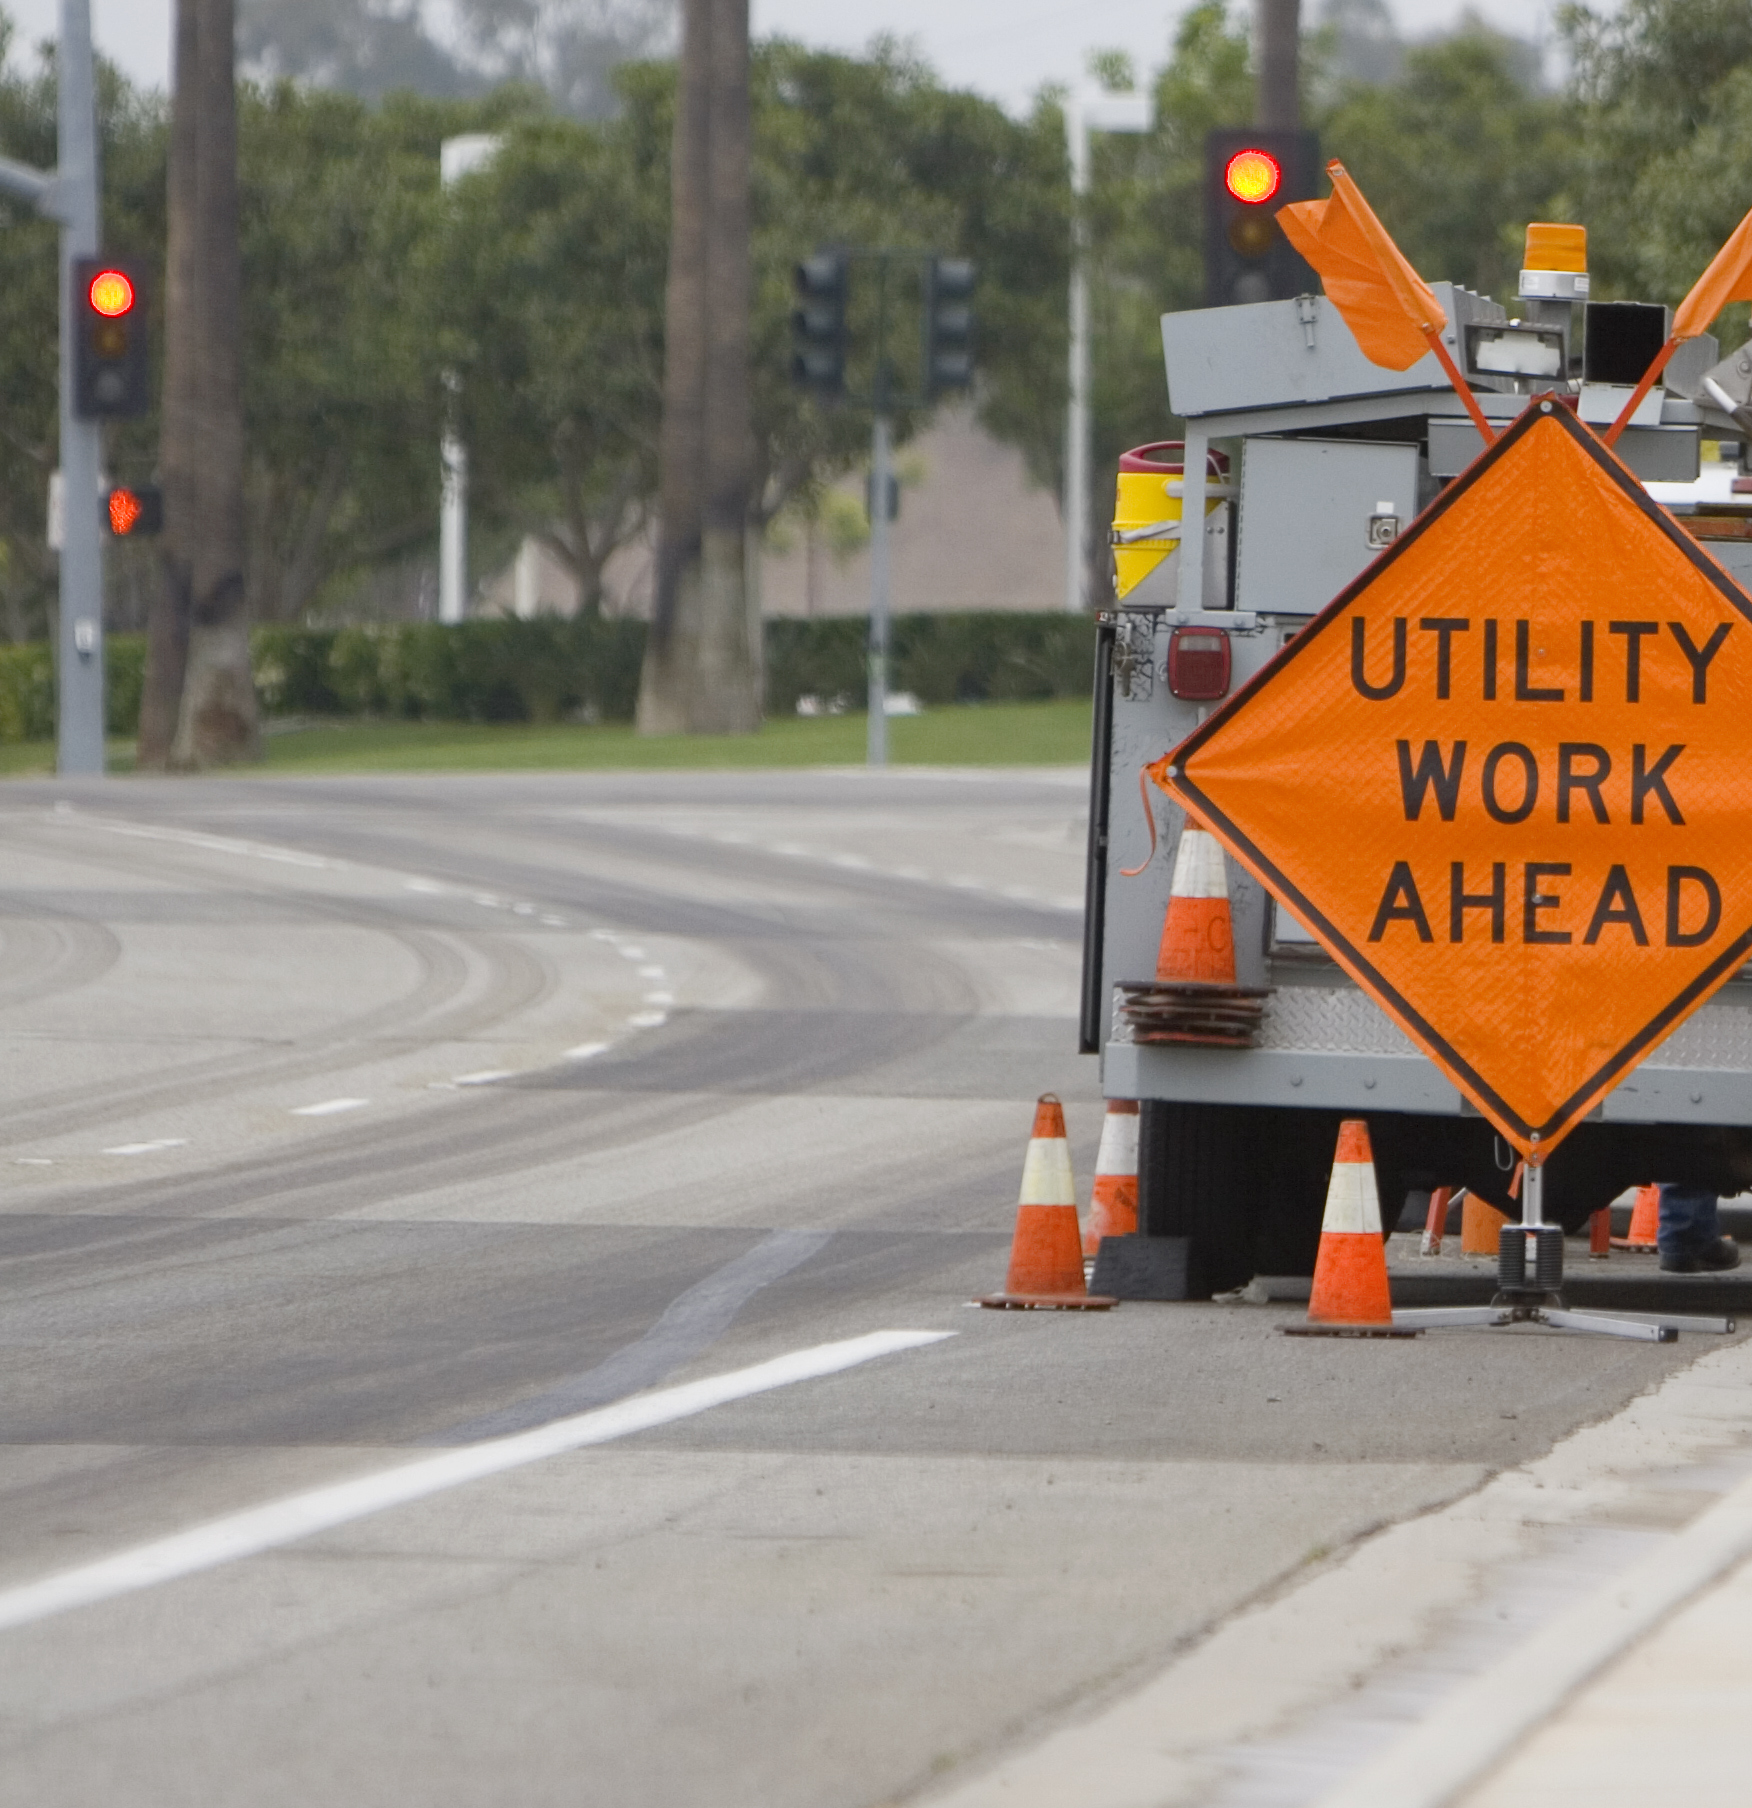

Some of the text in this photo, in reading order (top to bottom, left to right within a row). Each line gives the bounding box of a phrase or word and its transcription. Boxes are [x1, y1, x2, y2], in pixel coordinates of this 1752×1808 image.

[1351, 616, 1734, 704] UTILITY
[1396, 739, 1687, 825] WORK
[1368, 861, 1723, 947] AHEAD
